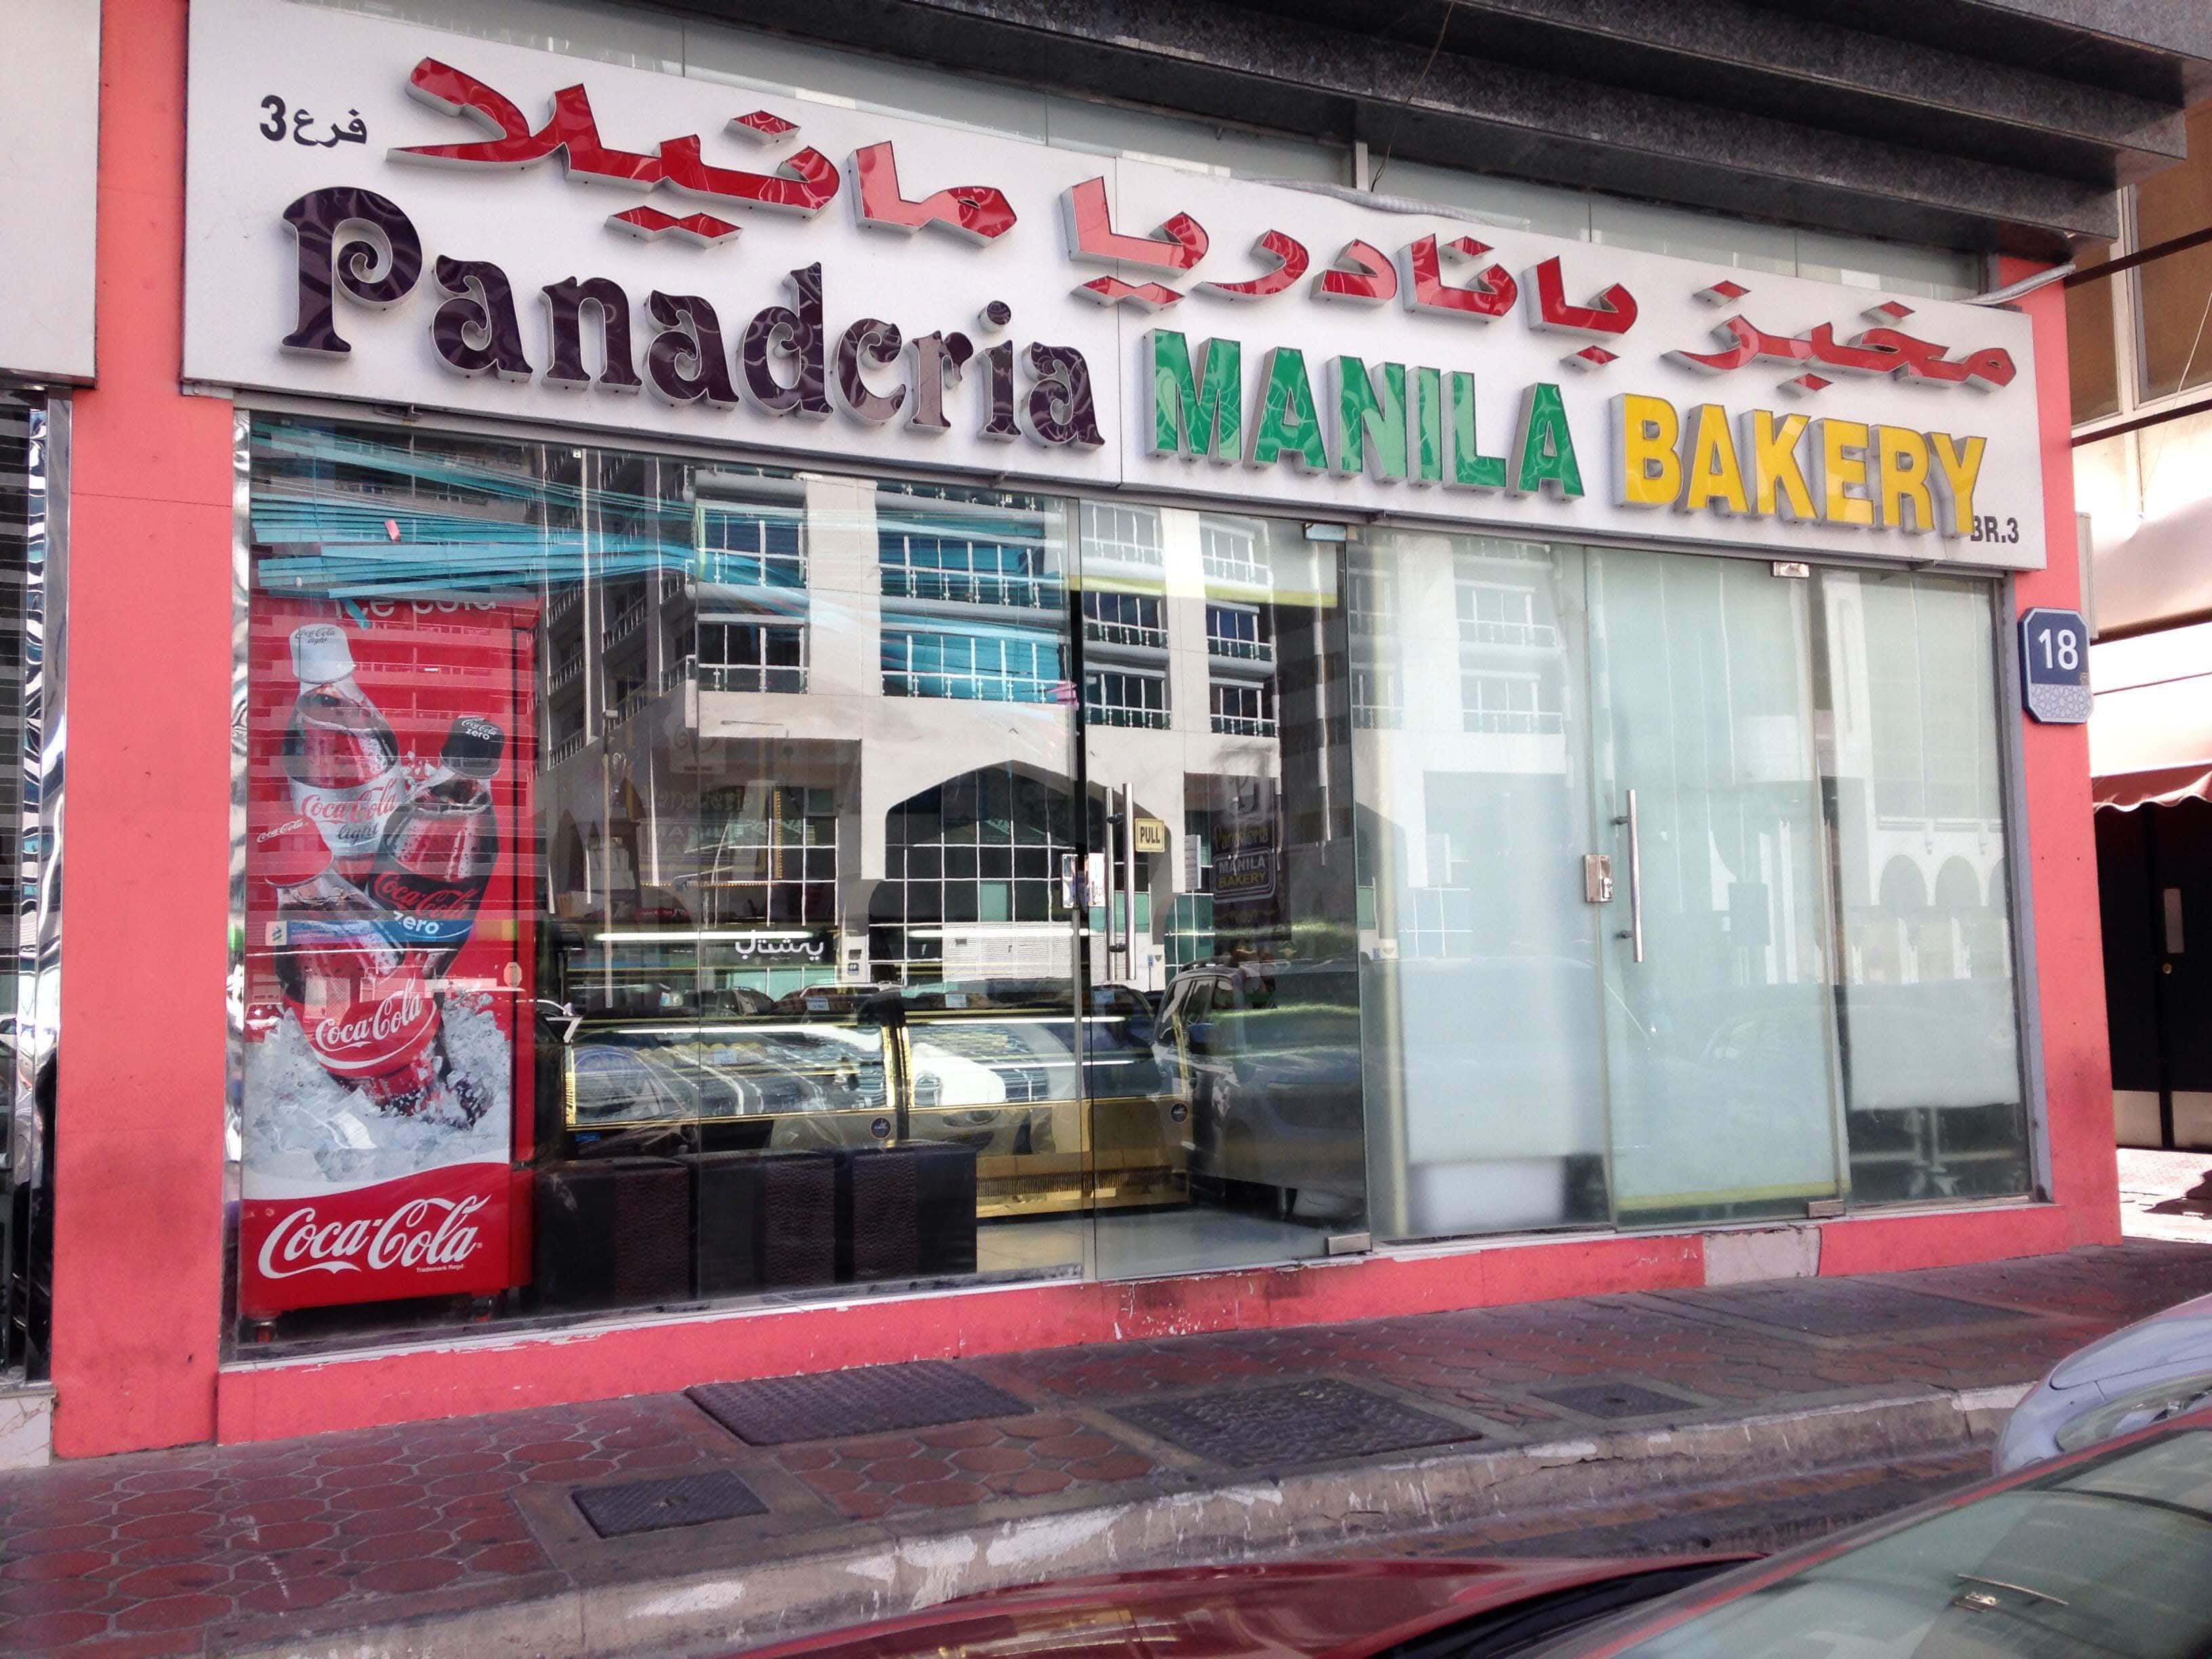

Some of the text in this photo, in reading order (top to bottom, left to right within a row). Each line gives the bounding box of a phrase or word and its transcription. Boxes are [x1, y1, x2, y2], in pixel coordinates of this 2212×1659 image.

[1662, 280, 2017, 393] مخبز
[279, 186, 1988, 540] Panaderia MANILA BAKERY
[1970, 515, 2020, 544] BR.3
[2038, 628, 2078, 670] 18
[465, 729, 490, 740] zero
[337, 822, 379, 845] light
[1140, 826, 1161, 844] PULL
[1219, 855, 1266, 874] MANILA
[1218, 871, 1267, 888] BAKERY
[258, 1193, 491, 1279] Coca-Cola
